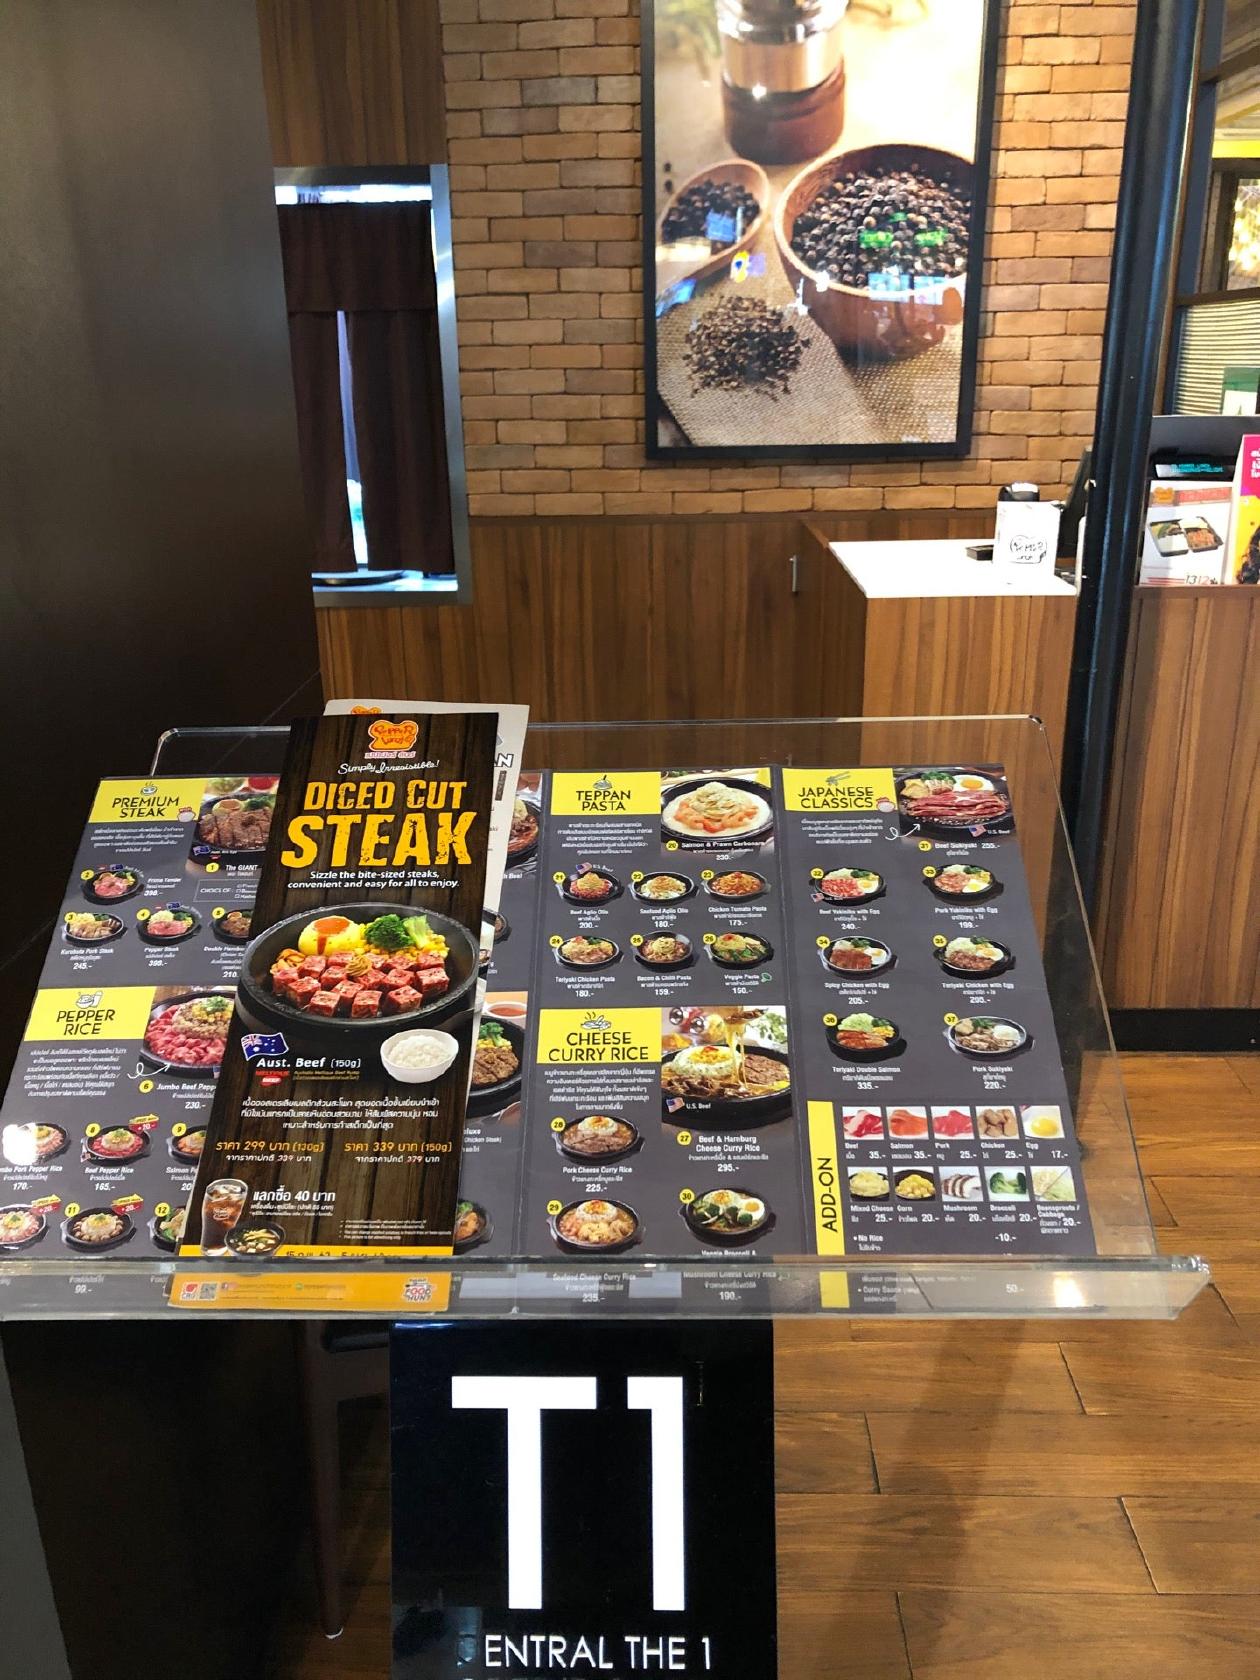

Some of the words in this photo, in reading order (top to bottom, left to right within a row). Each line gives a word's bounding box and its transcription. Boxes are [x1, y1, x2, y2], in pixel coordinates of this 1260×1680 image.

[338, 763, 376, 775] Simply
[375, 760, 440, 774] Irresistible!
[304, 780, 395, 810] DICED
[406, 779, 467, 810] CUT
[576, 790, 631, 800] TEPPAN
[798, 786, 874, 797] JAPANESE
[112, 796, 179, 808] PREMIUM
[582, 800, 626, 812] PASTA
[800, 797, 873, 809] CLASSICS
[119, 807, 165, 818] STEAK
[281, 811, 477, 869] STEAK
[310, 871, 338, 880] Sizzle
[339, 871, 356, 879] the
[358, 870, 405, 879] bite-sized
[407, 870, 440, 880] steaks,
[287, 880, 342, 889] convenient
[344, 880, 361, 888] and
[363, 881, 386, 890] easy
[388, 879, 402, 888] for
[404, 879, 417, 887] all
[418, 880, 428, 888] to
[430, 880, 460, 889] enjoy.
[56, 1009, 115, 1023] PEPPER
[64, 1023, 102, 1036] RICE
[567, 1031, 632, 1046] CHEESE
[549, 1048, 606, 1062] CURRY
[611, 1047, 649, 1060] RICE
[256, 1058, 291, 1068] Aust.
[296, 1057, 326, 1068] Beef
[699, 1135, 715, 1143] Beef
[724, 1135, 757, 1144] Hamburg
[216, 1140, 241, 1151] ราคา
[243, 1141, 266, 1151] 299
[269, 1141, 290, 1151] บาท
[344, 1141, 368, 1152] ราคา
[372, 1141, 393, 1151] 339
[397, 1142, 418, 1152] บาท
[723, 1145, 743, 1153] Curry
[744, 1144, 761, 1152] Rice
[869, 1151, 886, 1159] 35.-
[914, 1150, 931, 1159] 35.-
[960, 1150, 977, 1159] 25.-
[1005, 1150, 1022, 1159] 25.-
[562, 1166, 577, 1174] Pork
[578, 1166, 600, 1174] Cheese
[601, 1166, 618, 1175] Curry
[619, 1166, 633, 1174] Rice
[717, 1163, 739, 1172] 295.-
[586, 1183, 607, 1192] 225.-
[253, 1185, 291, 1201] แลกซื้อ
[294, 1190, 310, 1201] 40
[313, 1191, 336, 1202] บาท
[817, 1157, 838, 1233] ADD-ON
[943, 1204, 978, 1212] Mushroom
[875, 1214, 893, 1222] 25.-
[921, 1213, 940, 1222] 20.-
[968, 1213, 986, 1222] 20.-
[1019, 1213, 1037, 1222] 20.-
[451, 1375, 686, 1612] T1
[624, 1635, 686, 1670] THE
[701, 1636, 712, 1671] 1
